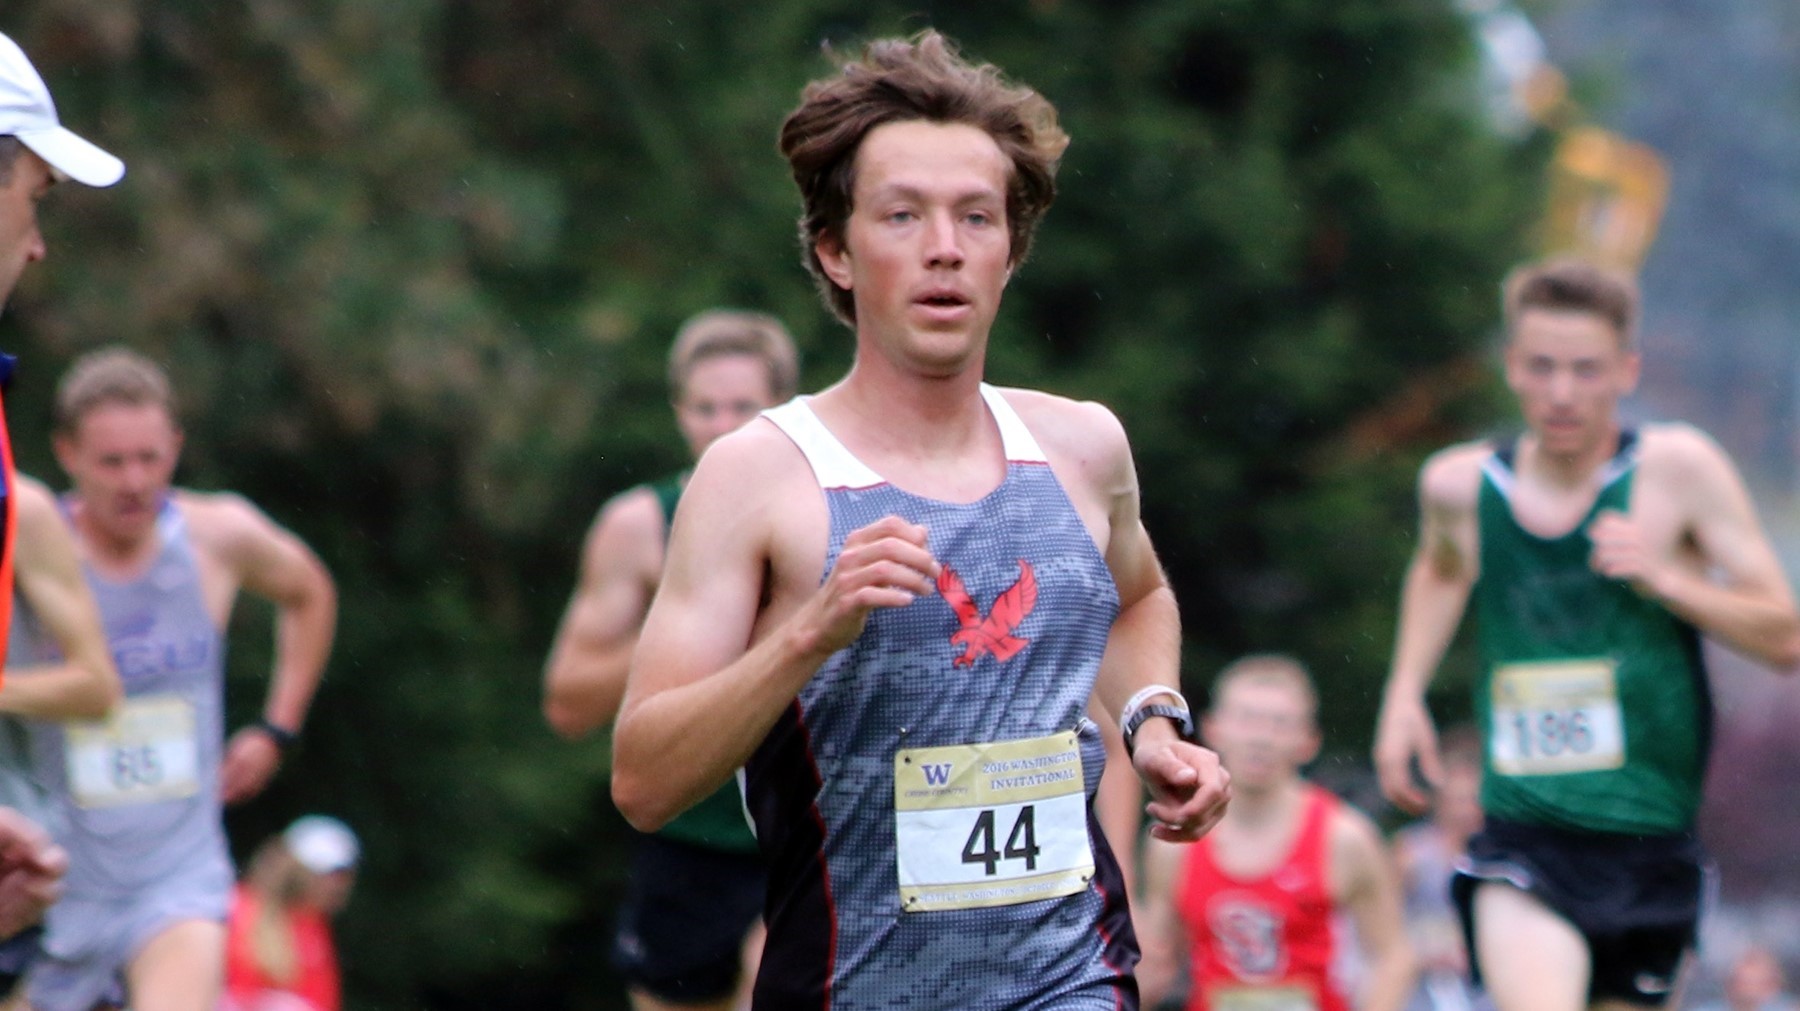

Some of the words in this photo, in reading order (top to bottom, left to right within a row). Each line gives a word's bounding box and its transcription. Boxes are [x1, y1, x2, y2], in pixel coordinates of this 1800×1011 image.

[1513, 711, 1596, 757] 186
[982, 761, 1009, 774] 2016
[1010, 751, 1077, 770] WASHINGTON
[921, 763, 953, 786] W
[990, 768, 1075, 790] INVITATIONAL
[961, 804, 1040, 876] 44
